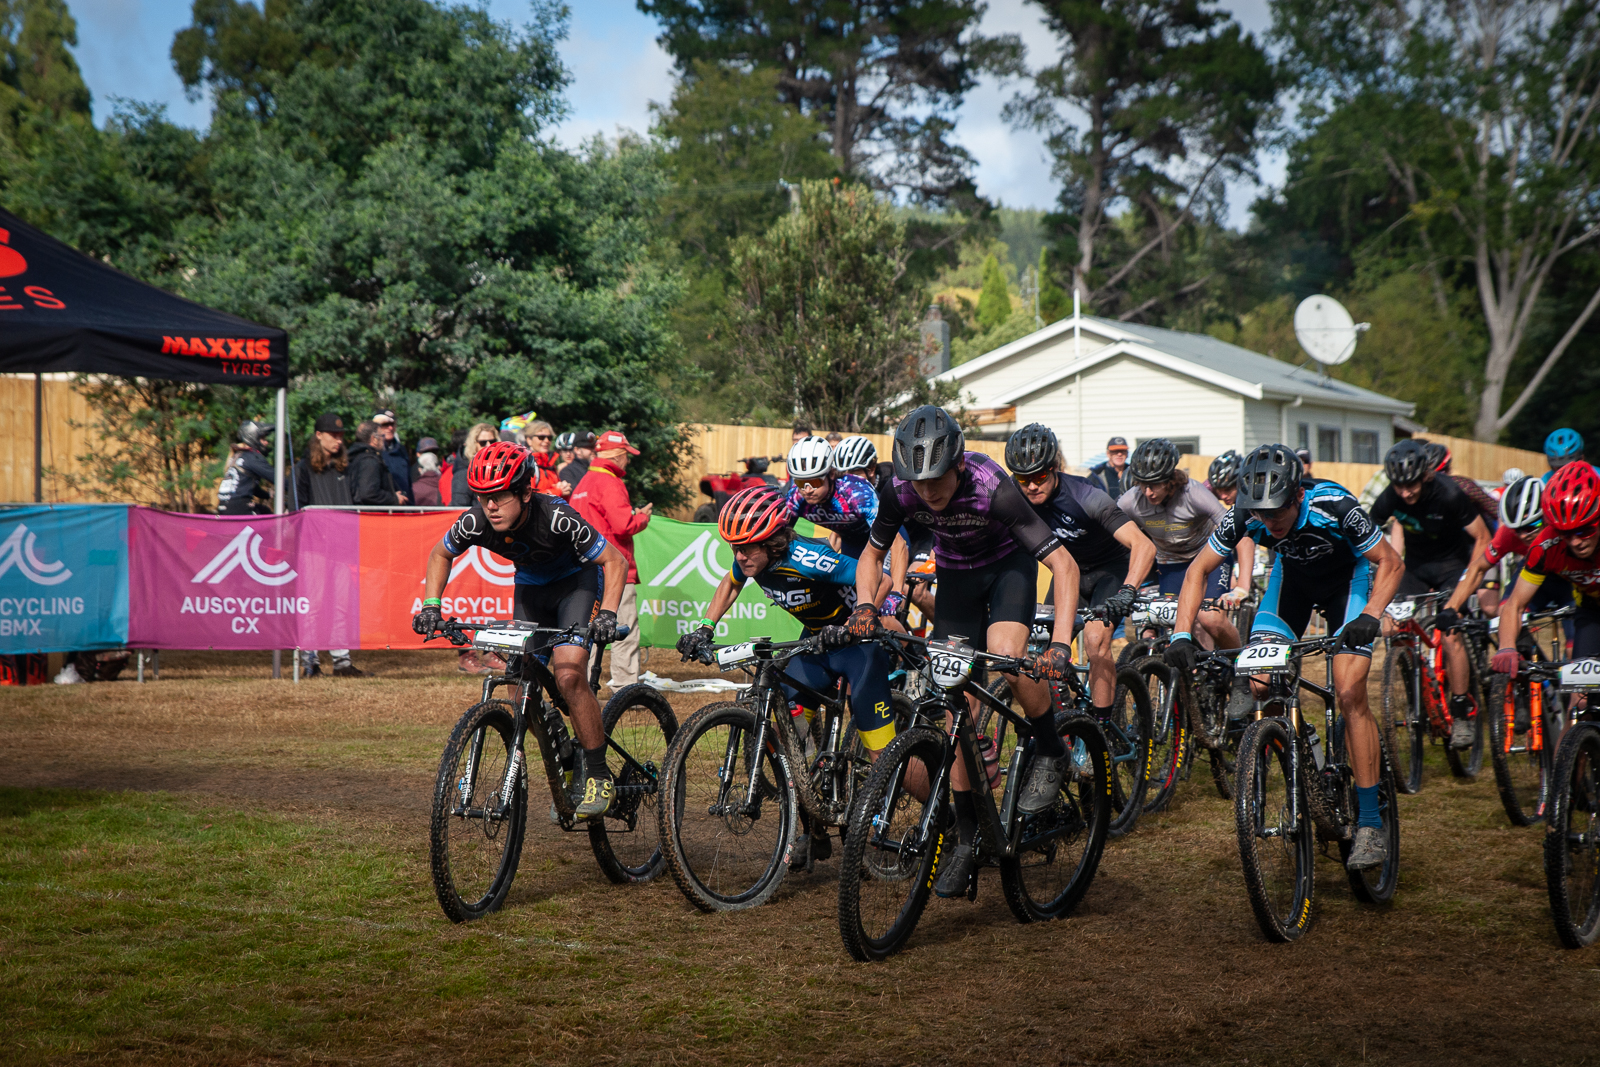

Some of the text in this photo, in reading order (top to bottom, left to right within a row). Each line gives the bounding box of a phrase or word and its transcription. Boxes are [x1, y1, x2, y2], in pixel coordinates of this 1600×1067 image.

[161, 336, 271, 361] MAXXIS
[222, 361, 272, 377] TYRES
[791, 545, 839, 573] 32Gi
[180, 596, 310, 614] AUSCYCLING
[410, 597, 514, 614] ASCYCLI
[639, 599, 766, 619] AUSCYING
[1156, 606, 1178, 620] 207
[0, 619, 41, 636] BMX
[231, 617, 260, 634] CX
[676, 619, 729, 637] ROD
[1247, 646, 1280, 659] 203
[932, 656, 962, 677] 229
[1103, 751, 1112, 795] MAXXIS
[1297, 898, 1311, 929] MAXXIS
